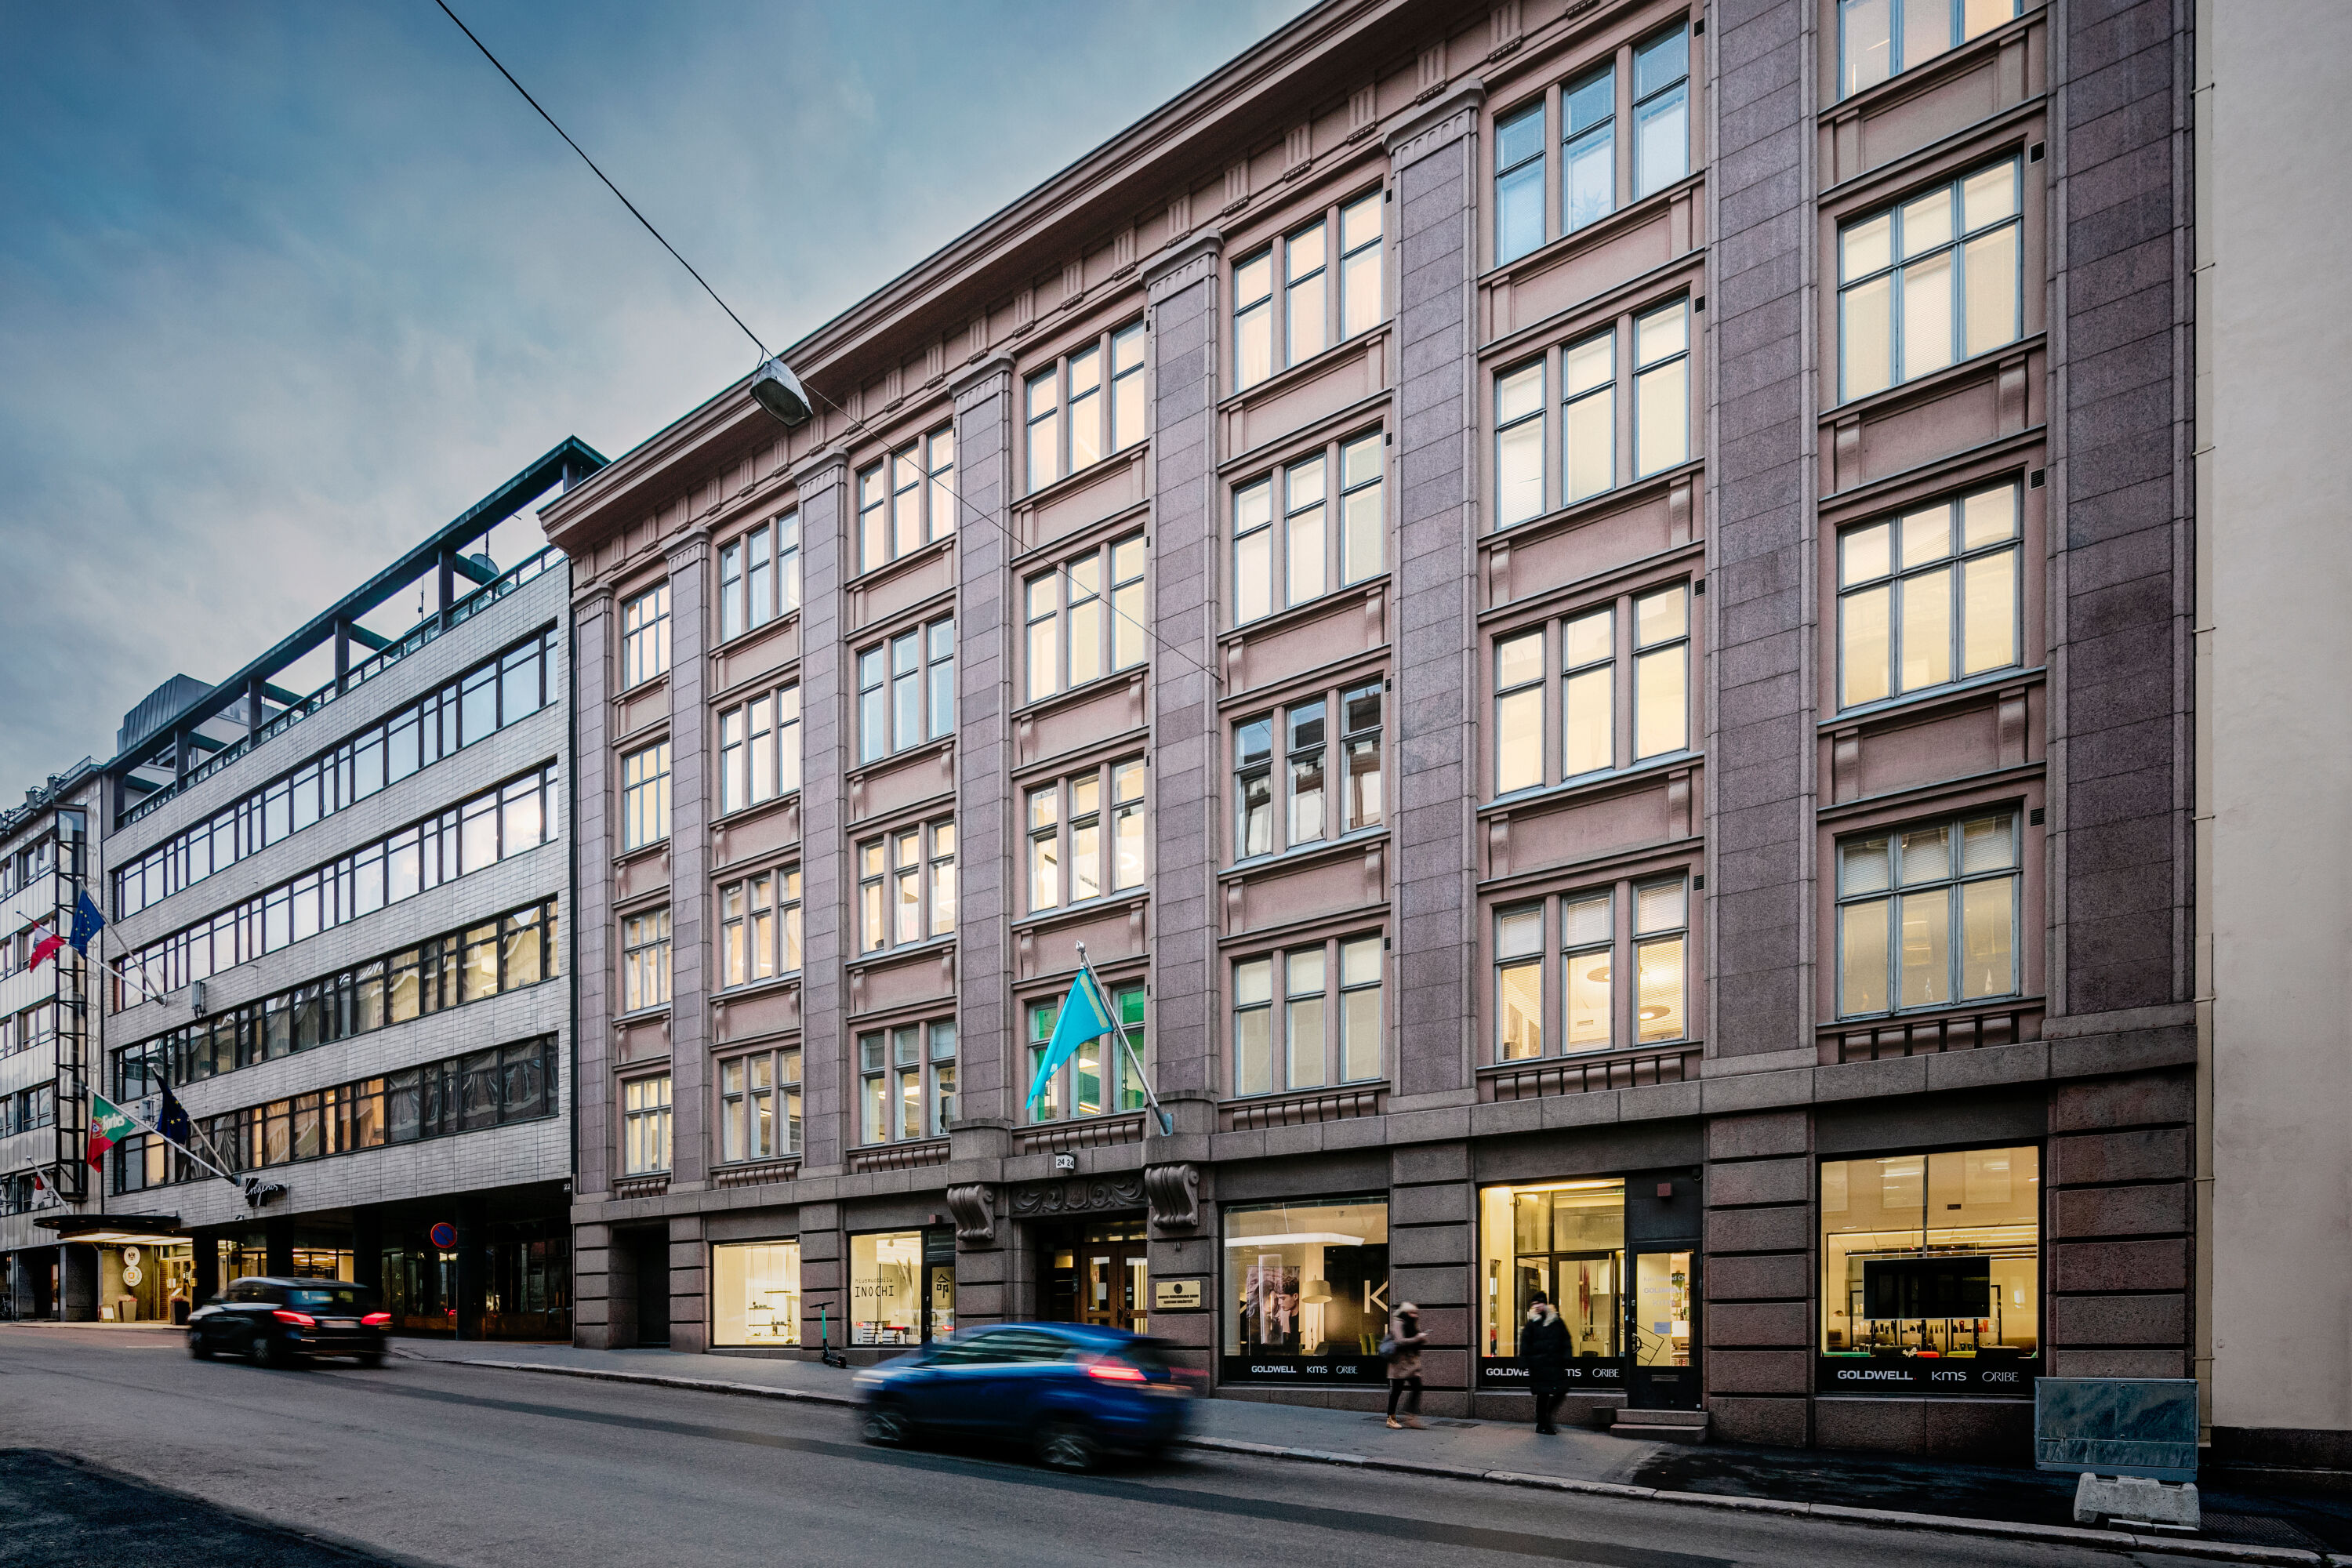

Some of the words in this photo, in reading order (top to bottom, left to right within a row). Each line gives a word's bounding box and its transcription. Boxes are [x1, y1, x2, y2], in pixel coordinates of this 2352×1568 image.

[855, 1285, 895, 1298] INOCHI
[1336, 1366, 1358, 1374] ORIBE
[1486, 1368, 1530, 1377] GOLDWE
[1592, 1368, 1620, 1378] ORIBE
[1982, 1371, 2020, 1382] ORIBE
